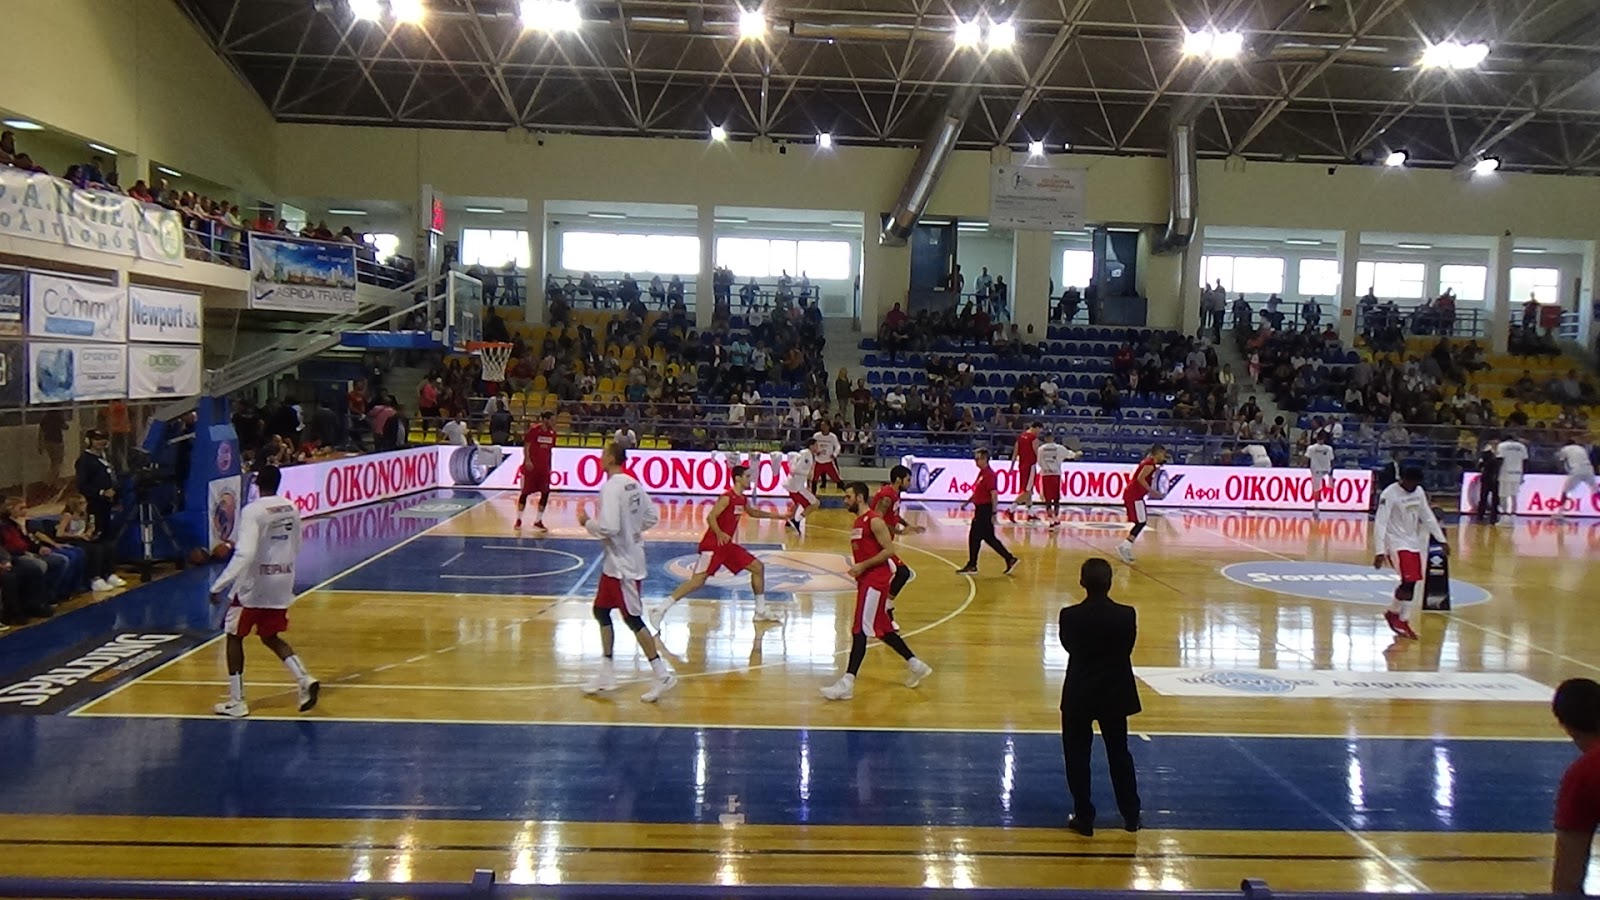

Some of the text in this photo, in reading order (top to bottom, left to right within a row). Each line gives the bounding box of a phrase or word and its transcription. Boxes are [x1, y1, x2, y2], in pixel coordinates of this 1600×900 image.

[276, 287, 356, 303] ASPIDA TRAVEL
[131, 297, 183, 332] Newport
